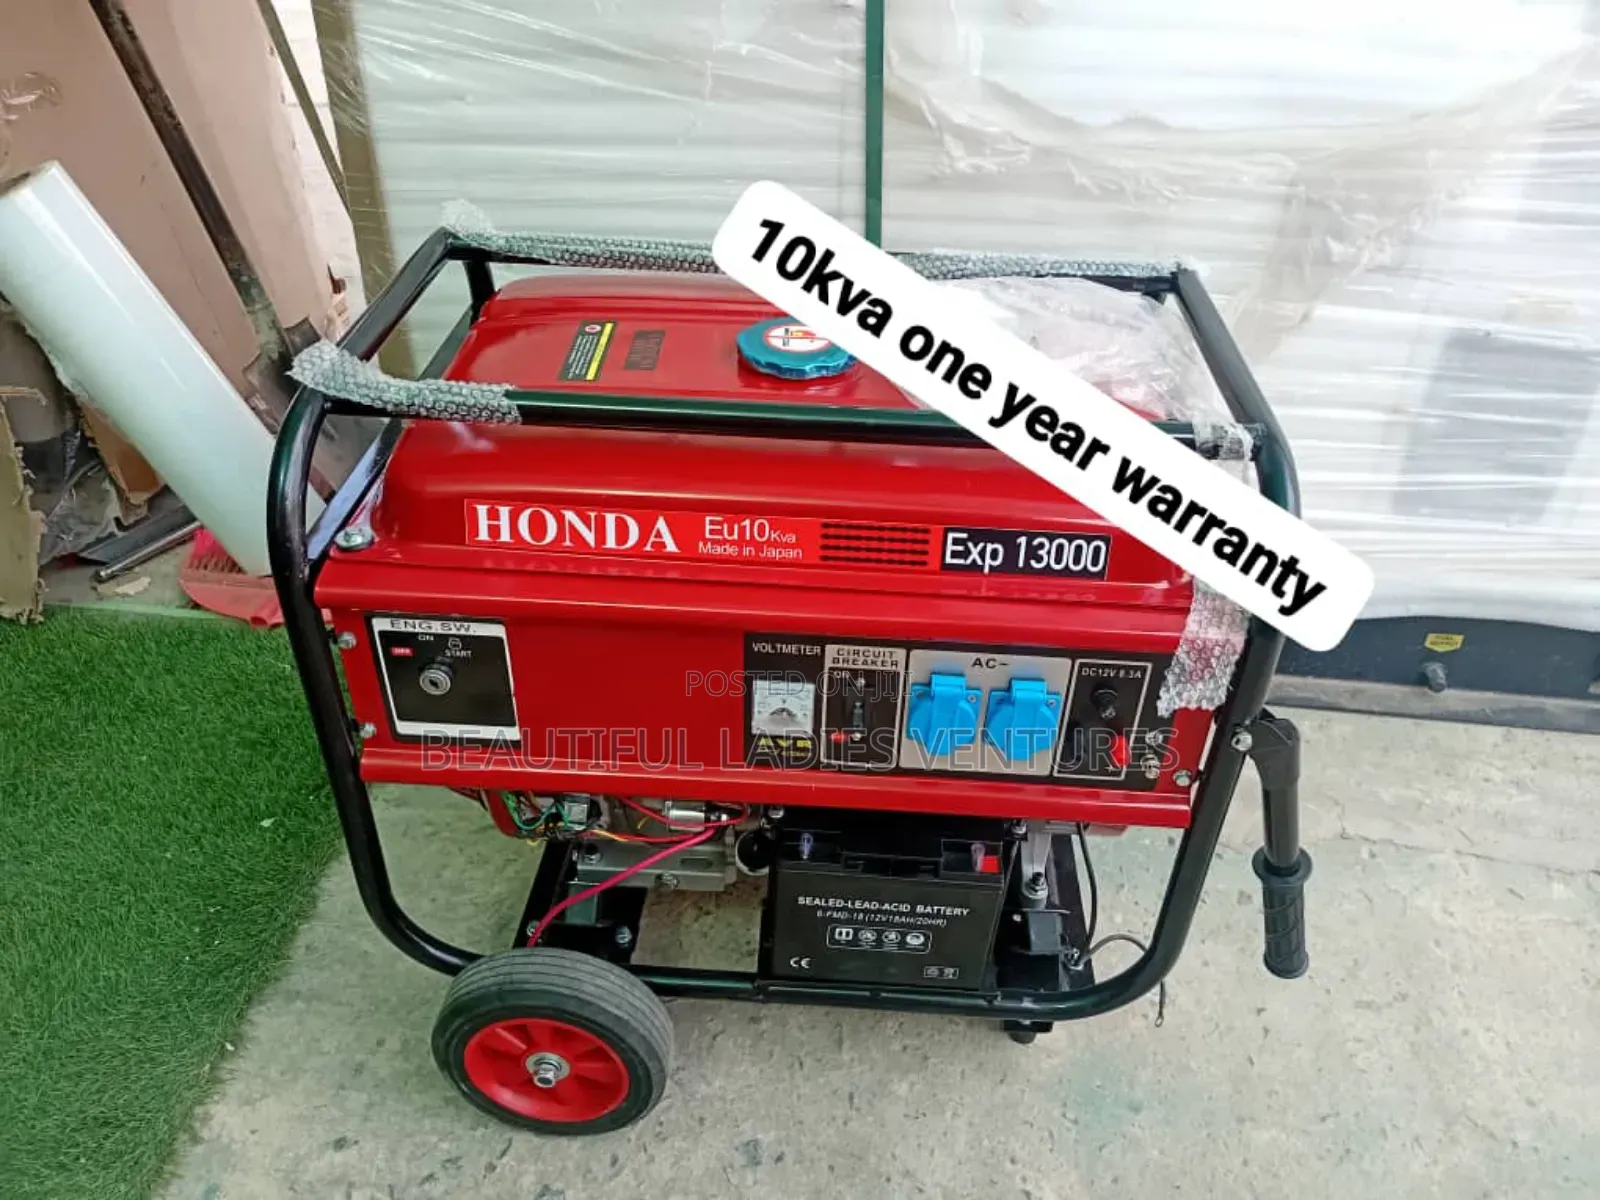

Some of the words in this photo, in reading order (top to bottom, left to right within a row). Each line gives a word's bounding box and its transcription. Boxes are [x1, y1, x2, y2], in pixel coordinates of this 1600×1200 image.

[473, 503, 681, 553] HONDA
[698, 540, 738, 556] Made
[743, 544, 756, 556] in
[759, 544, 803, 560] Japan
[944, 532, 1005, 575] Exp
[1016, 536, 1107, 573] 13000
[444, 649, 472, 658] START
[752, 642, 822, 657] VOLTMETER
[837, 649, 898, 659] CIRCUIT
[832, 657, 900, 669] BREAKER
[798, 896, 911, 913] SEALED-LEAD-ACID
[916, 904, 970, 916] BATTERY
